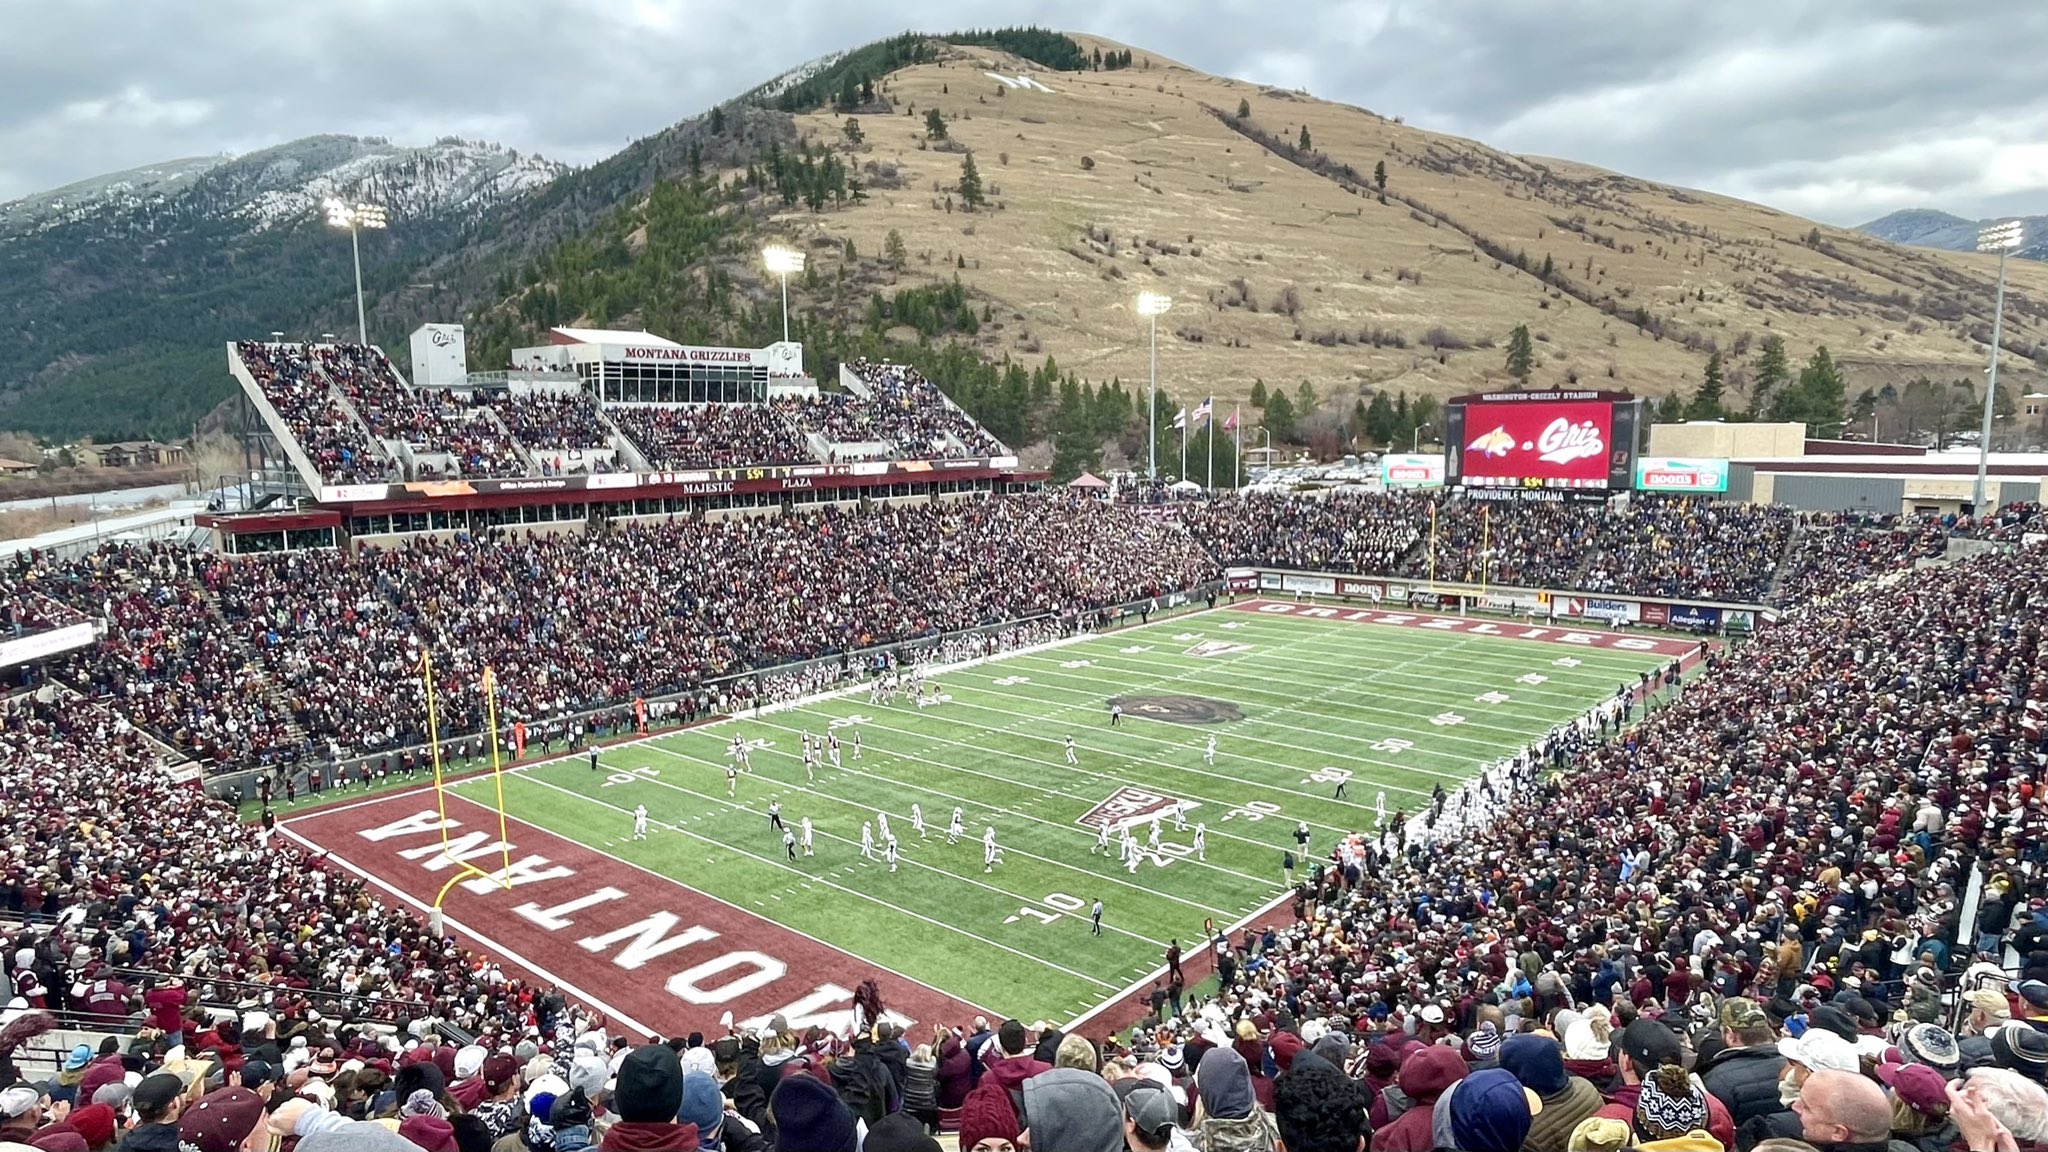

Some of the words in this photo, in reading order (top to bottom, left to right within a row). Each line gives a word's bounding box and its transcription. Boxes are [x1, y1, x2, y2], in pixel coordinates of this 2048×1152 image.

[625, 347, 688, 361] MONTANA
[690, 350, 752, 363] GRIZZLIES
[1537, 416, 1604, 465] Griz
[683, 481, 735, 495] MAJESTIC
[782, 478, 813, 489] PLAZA
[1467, 489, 1519, 501] PROVIDENCE
[1520, 490, 1565, 502] MONTANA
[1588, 599, 1628, 612] Builders
[1258, 603, 1660, 650] GRIZZLIES
[1230, 800, 1282, 822] 30
[1019, 892, 1087, 925] 10
